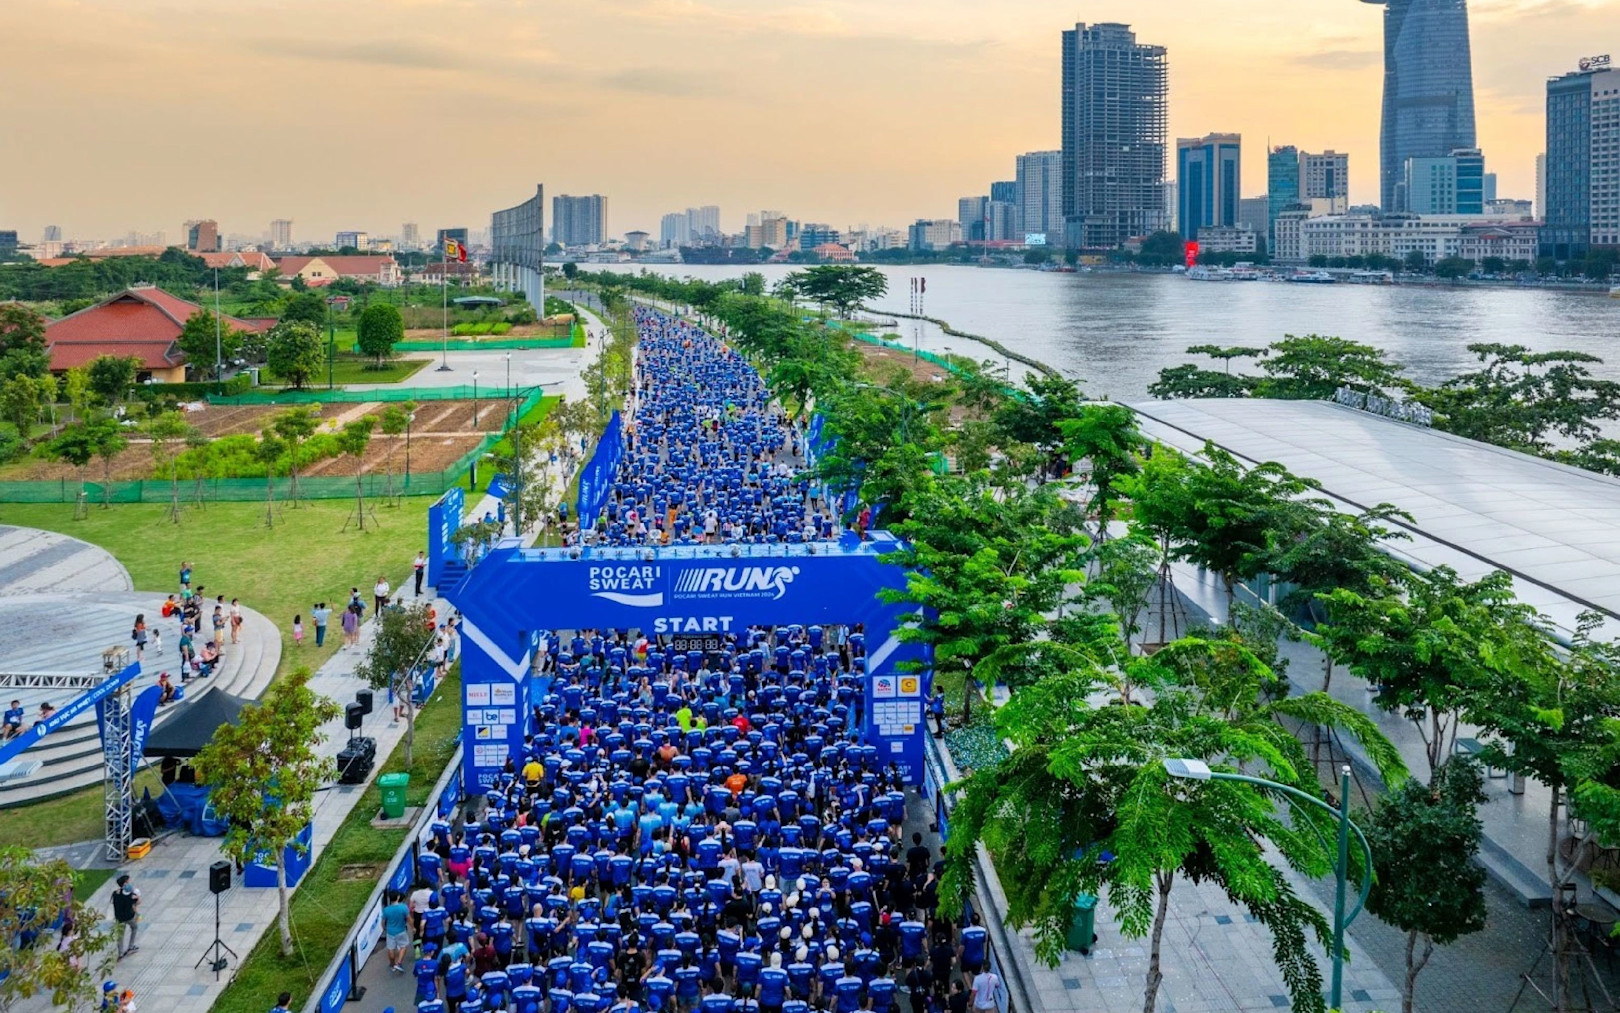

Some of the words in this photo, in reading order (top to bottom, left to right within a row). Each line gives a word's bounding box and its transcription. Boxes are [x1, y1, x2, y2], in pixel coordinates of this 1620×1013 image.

[1591, 54, 1610, 64] SCB
[589, 566, 661, 578] POCARI
[589, 578, 655, 590] SWEAT
[653, 616, 734, 633] START
